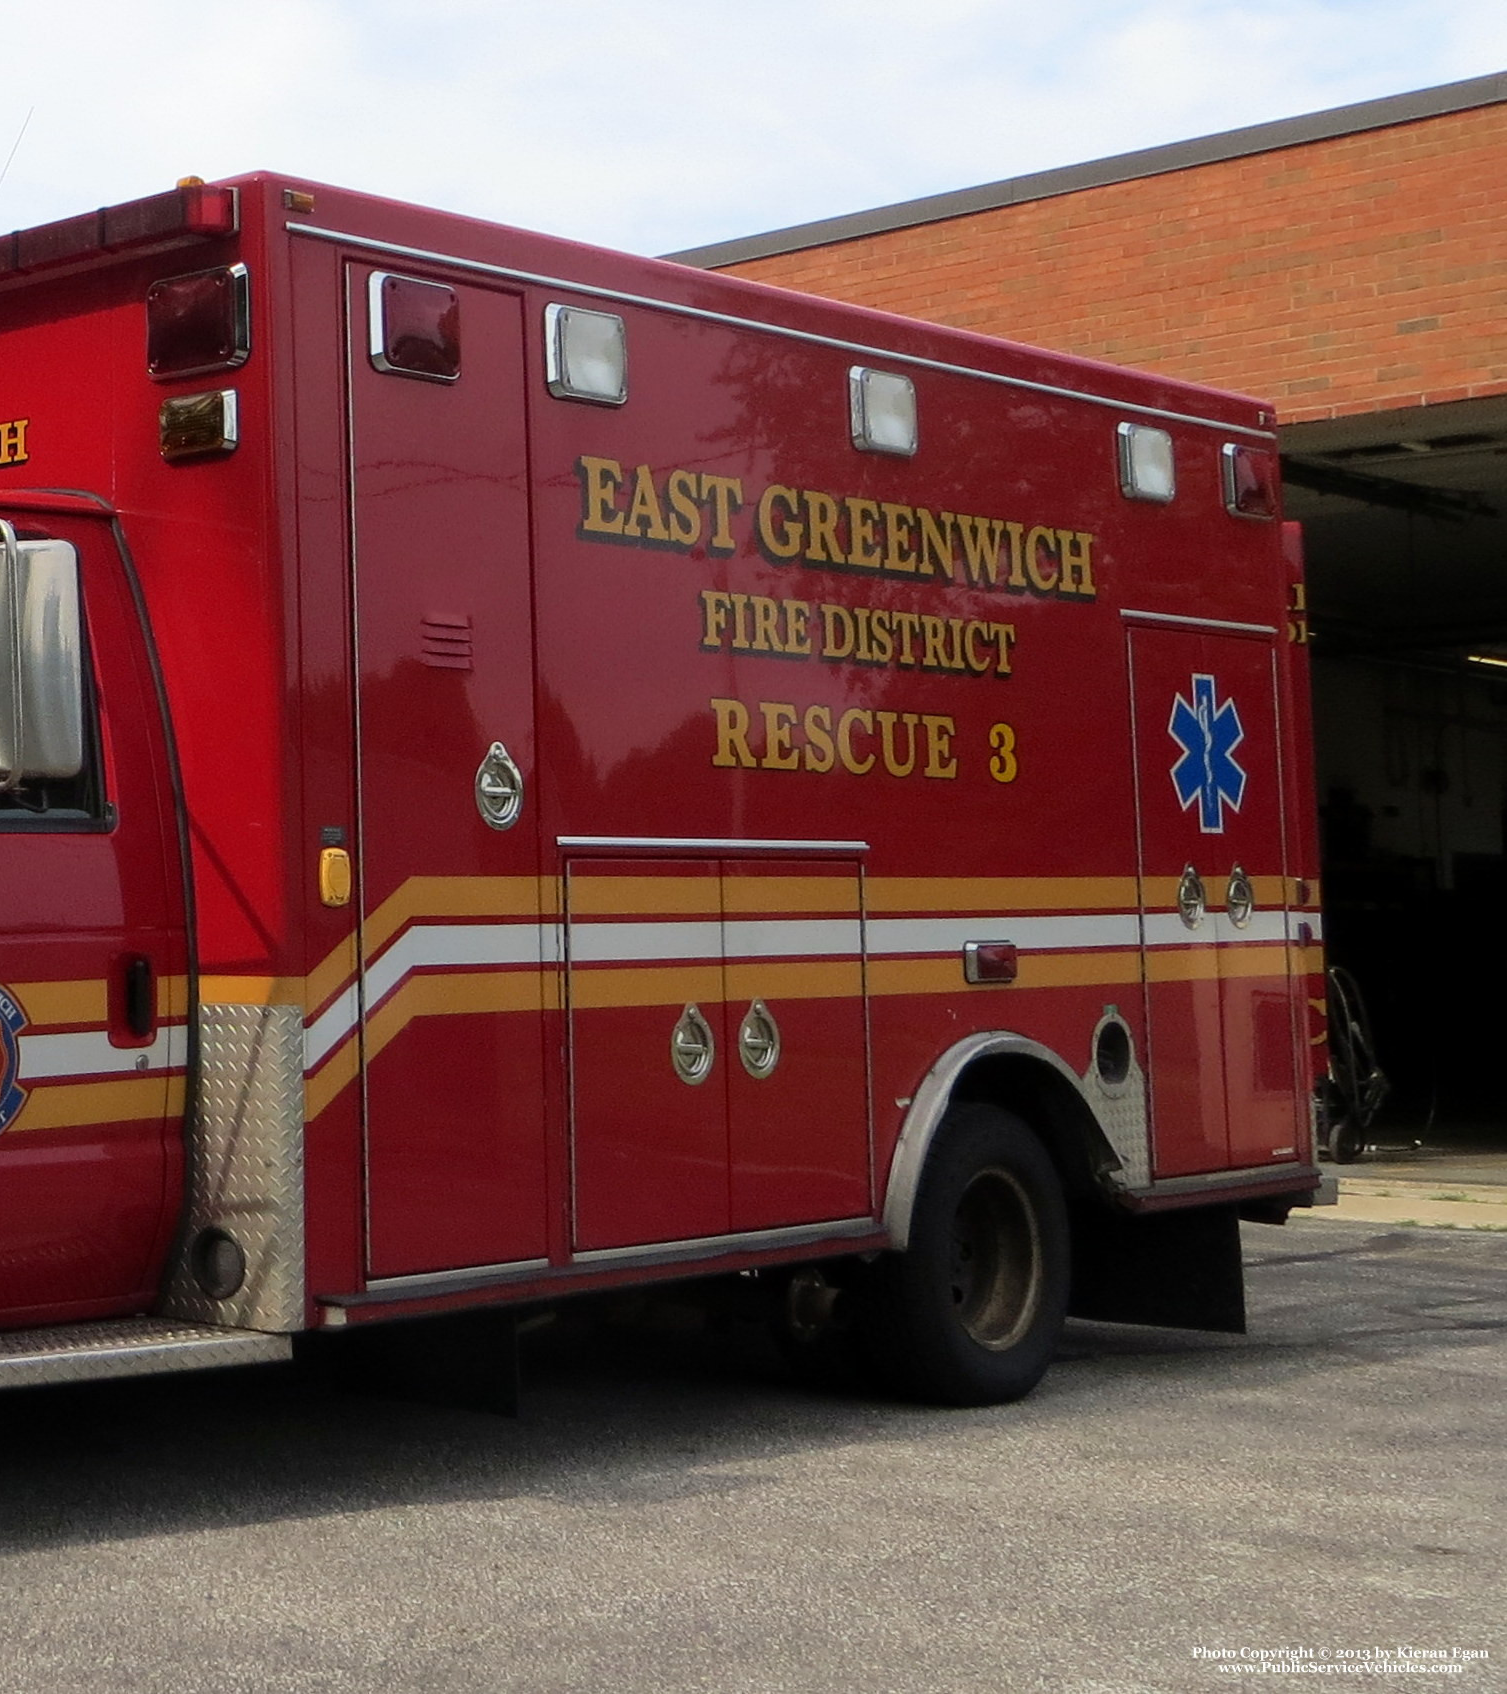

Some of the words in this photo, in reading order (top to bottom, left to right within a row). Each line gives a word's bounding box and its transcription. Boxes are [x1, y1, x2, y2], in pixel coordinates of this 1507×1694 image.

[579, 455, 742, 549] EAST
[758, 484, 1096, 598] GREENWICH
[701, 590, 812, 656] FIRE
[822, 603, 1015, 676] DISTRICT
[710, 698, 958, 780] RESCUE
[988, 723, 1019, 783] 3
